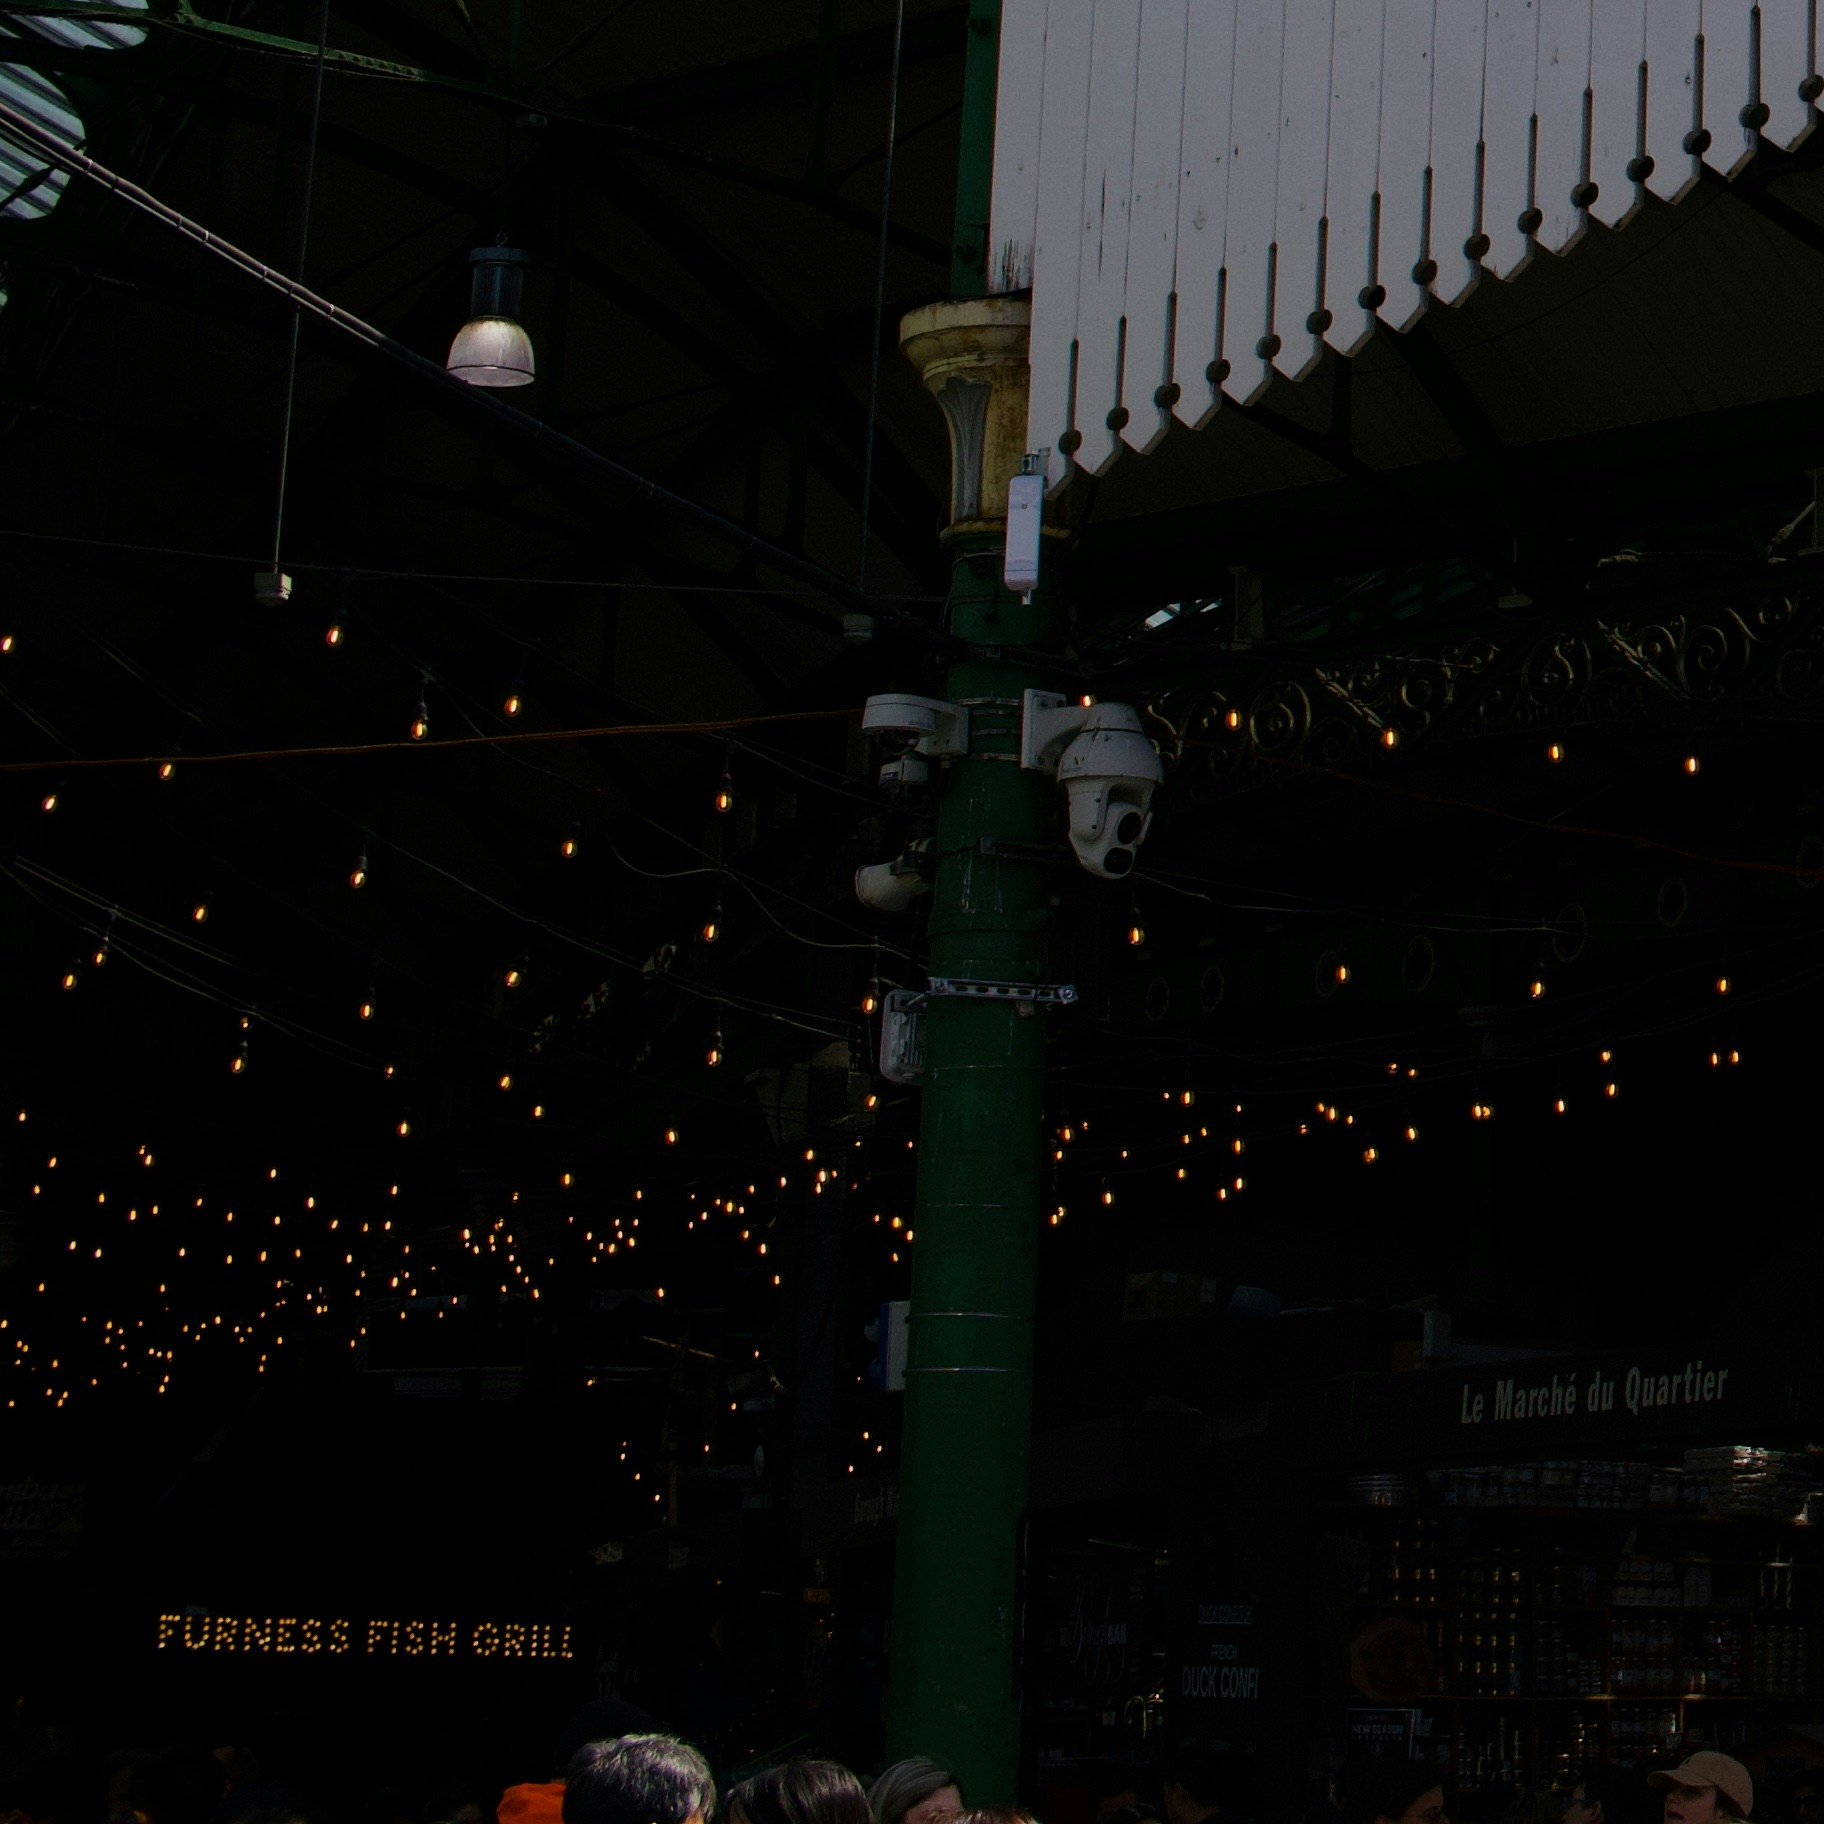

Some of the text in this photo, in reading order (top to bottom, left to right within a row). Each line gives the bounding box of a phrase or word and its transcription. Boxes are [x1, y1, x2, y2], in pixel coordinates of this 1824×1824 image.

[1460, 1360, 1729, 1424] Le Marché du Quartier
[157, 1613, 575, 1660] FURNESS FISH GRILL
[1182, 1665, 1217, 1698] DUCK
